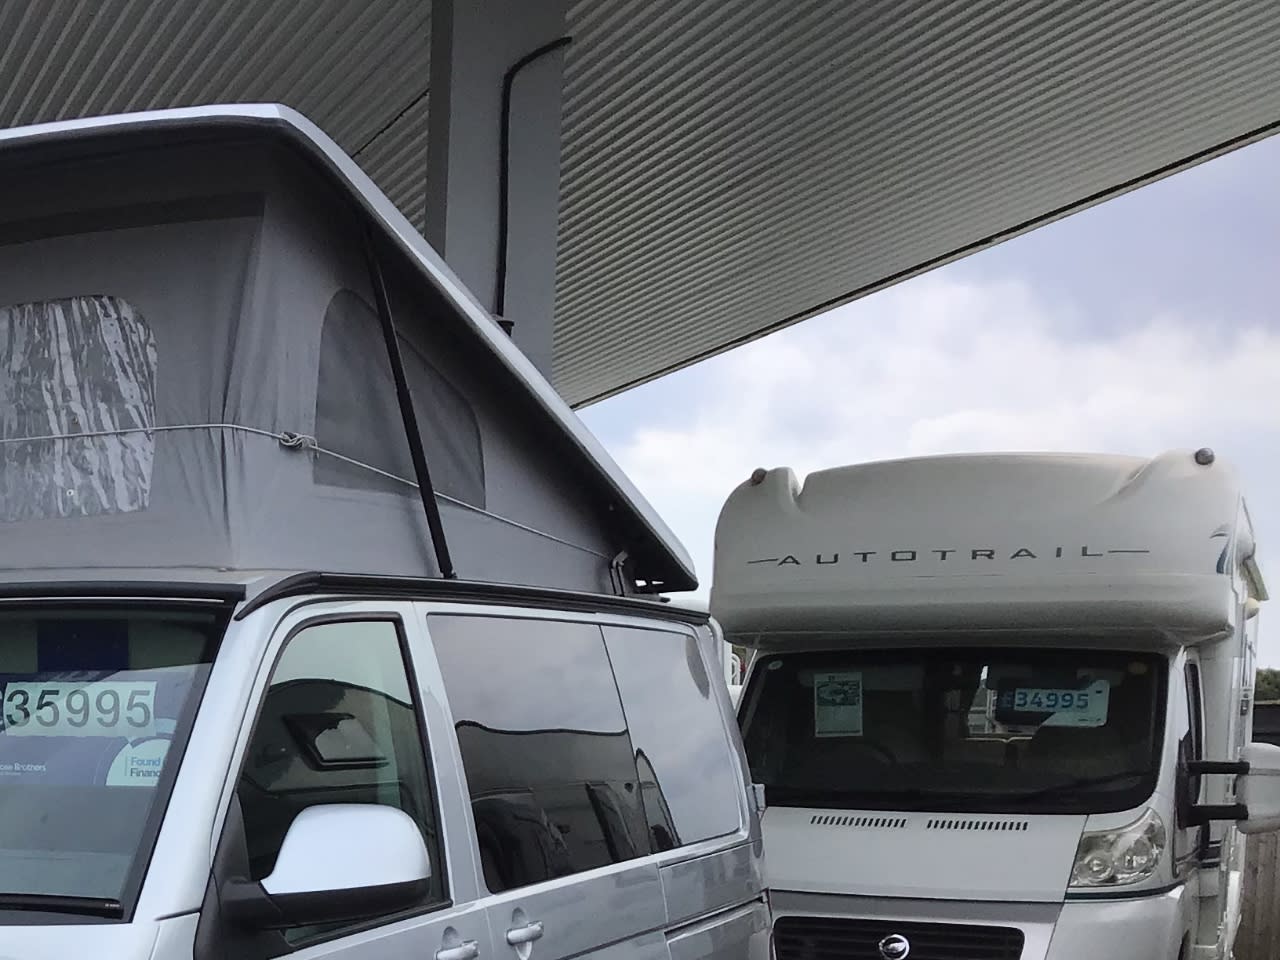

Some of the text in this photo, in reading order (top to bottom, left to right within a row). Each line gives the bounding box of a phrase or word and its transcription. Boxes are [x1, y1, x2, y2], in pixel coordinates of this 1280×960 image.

[777, 545, 1104, 566] AUTOTRAIL
[130, 756, 161, 766] Found
[14, 762, 47, 772] Brothers
[130, 766, 161, 777] Financ
